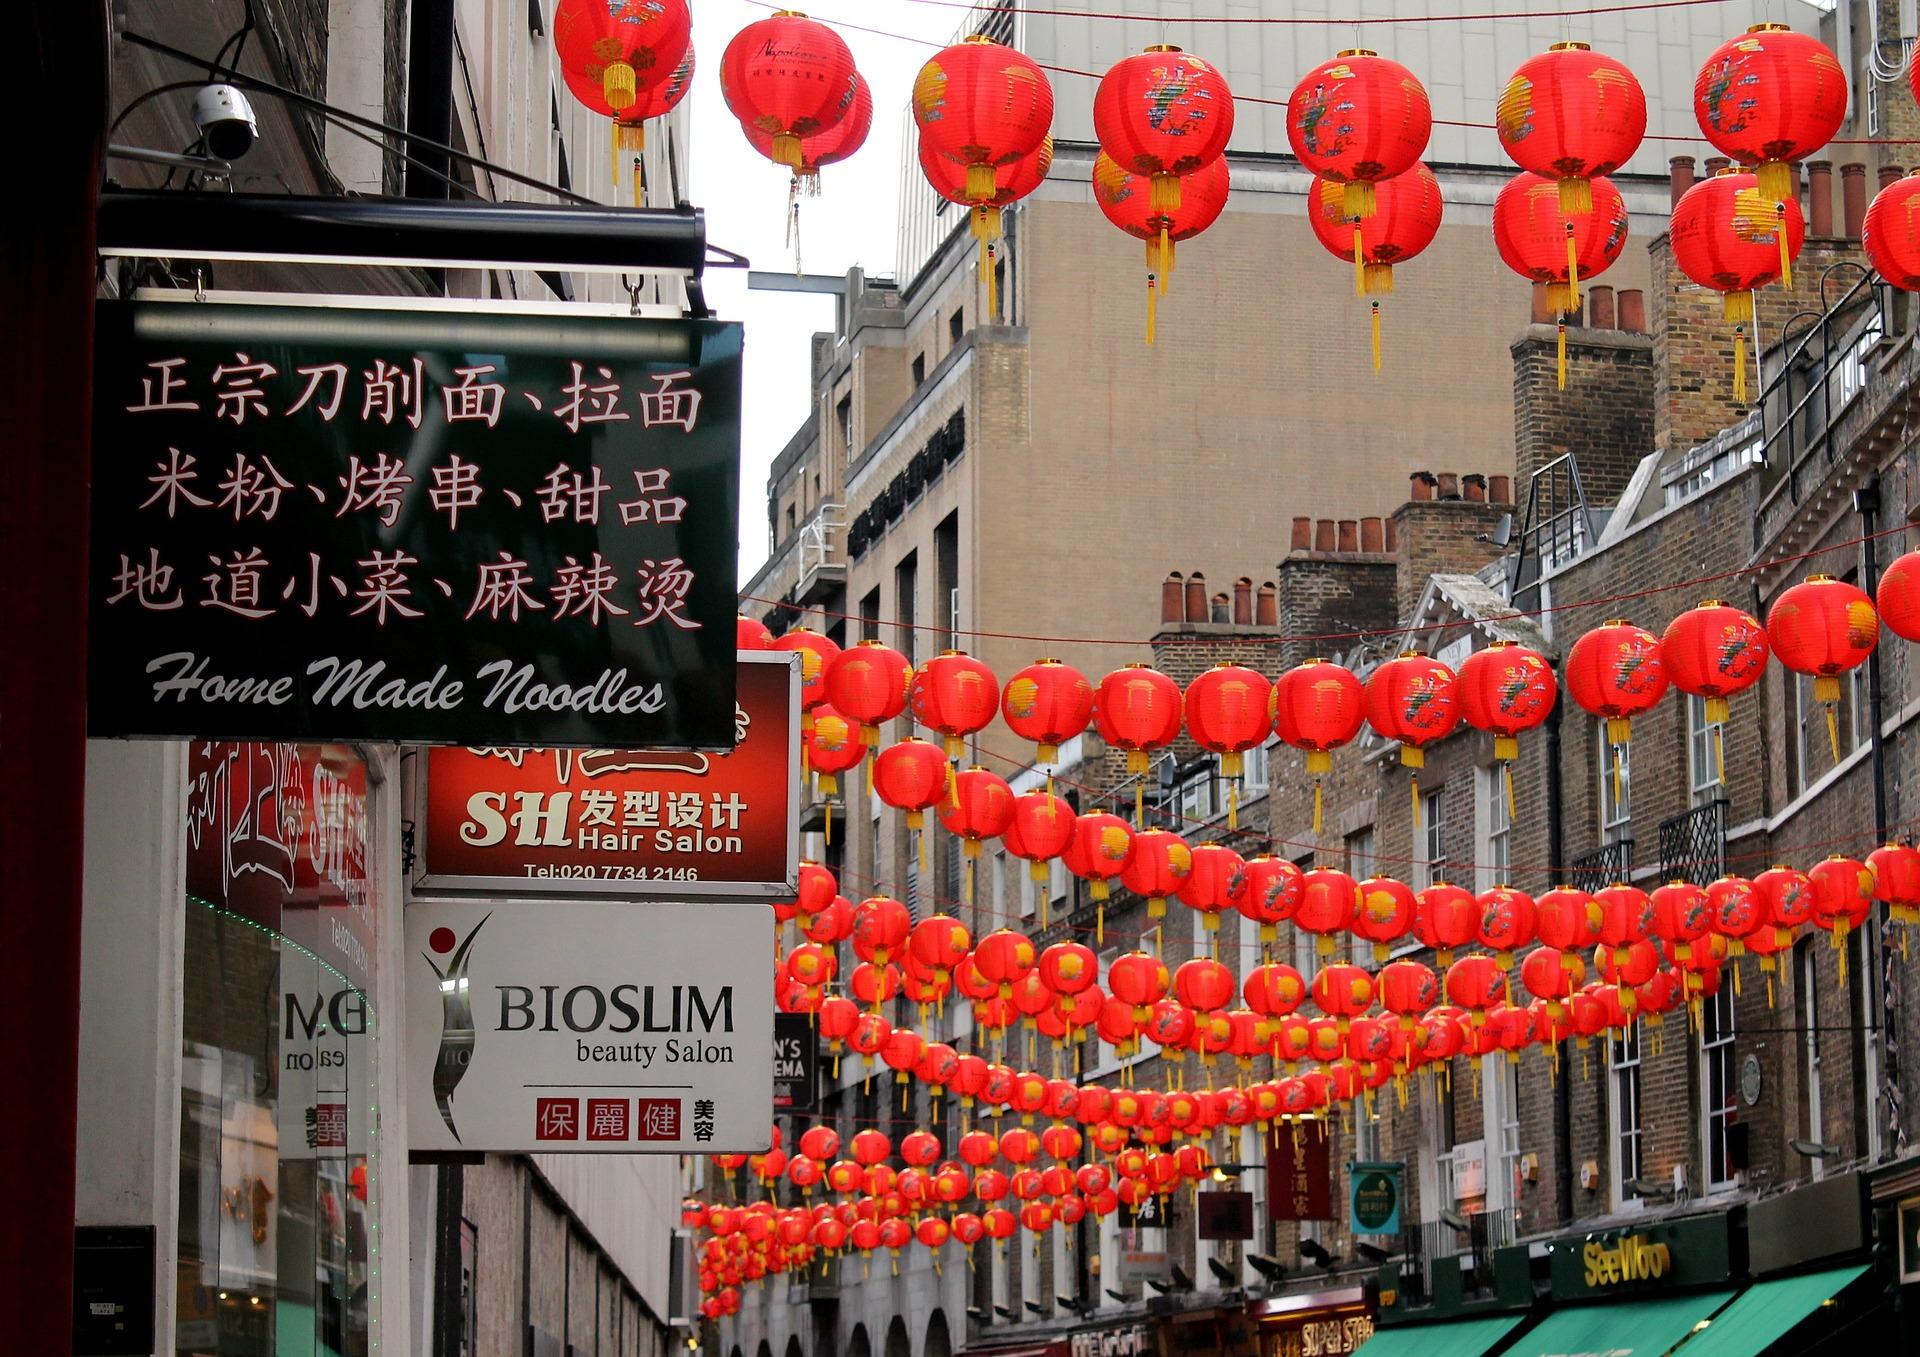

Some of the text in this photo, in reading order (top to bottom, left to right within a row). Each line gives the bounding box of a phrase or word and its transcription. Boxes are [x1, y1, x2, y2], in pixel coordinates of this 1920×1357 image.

[126, 353, 702, 433] 正宗刀削面、拉面
[139, 447, 687, 530] 米粉、烤串、甜品
[106, 546, 702, 630] 地道小菜、麻辣烫
[146, 652, 667, 715] Home Made Noodles
[460, 791, 572, 847] SH
[578, 790, 747, 829] 发型设计
[578, 829, 742, 853] Hair Salon
[523, 864, 698, 882] Tel:020 7734 2146
[494, 984, 734, 1033] BIOSLIM
[577, 1039, 734, 1068] beauty Salon
[540, 1103, 677, 1137] 保麗健
[693, 1099, 714, 1142] 美容
[1583, 1235, 1667, 1287] SeeWoo
